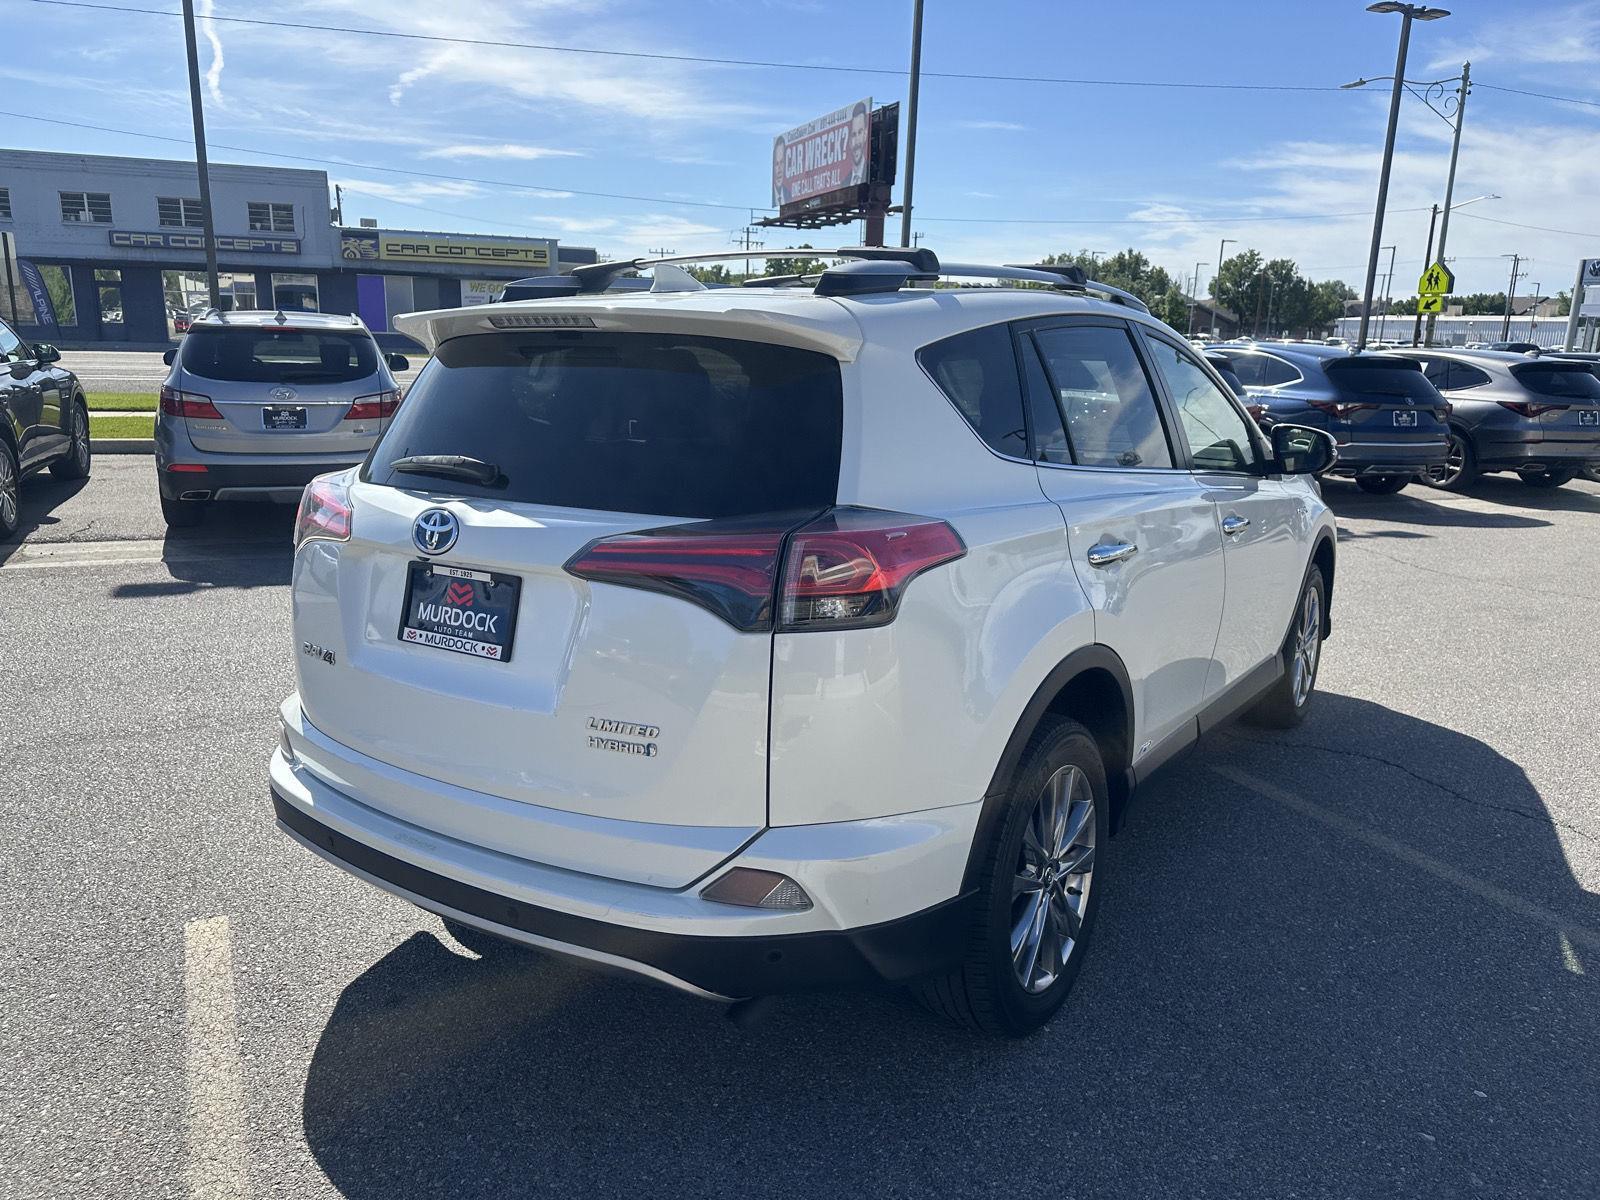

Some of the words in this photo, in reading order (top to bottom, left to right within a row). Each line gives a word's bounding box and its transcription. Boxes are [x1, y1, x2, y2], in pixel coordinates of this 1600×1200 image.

[785, 145, 803, 178] CAR
[804, 126, 849, 172] WRECK?
[802, 176, 814, 194] CALL
[831, 168, 841, 187] ALL
[112, 233, 164, 246] CAR
[386, 243, 430, 254] CAR
[434, 245, 547, 259] CONCEPTS
[469, 281, 485, 293] WE
[31, 284, 53, 325] ALPINE
[449, 569, 460, 577] EST.
[460, 570, 473, 579] 1925
[417, 602, 499, 634] MURDOCK
[434, 625, 452, 635] AUTO
[455, 629, 474, 639] TEAM
[424, 633, 479, 653] MURDOCK
[586, 716, 660, 739] LIMITED
[588, 735, 647, 756] HYBRID
